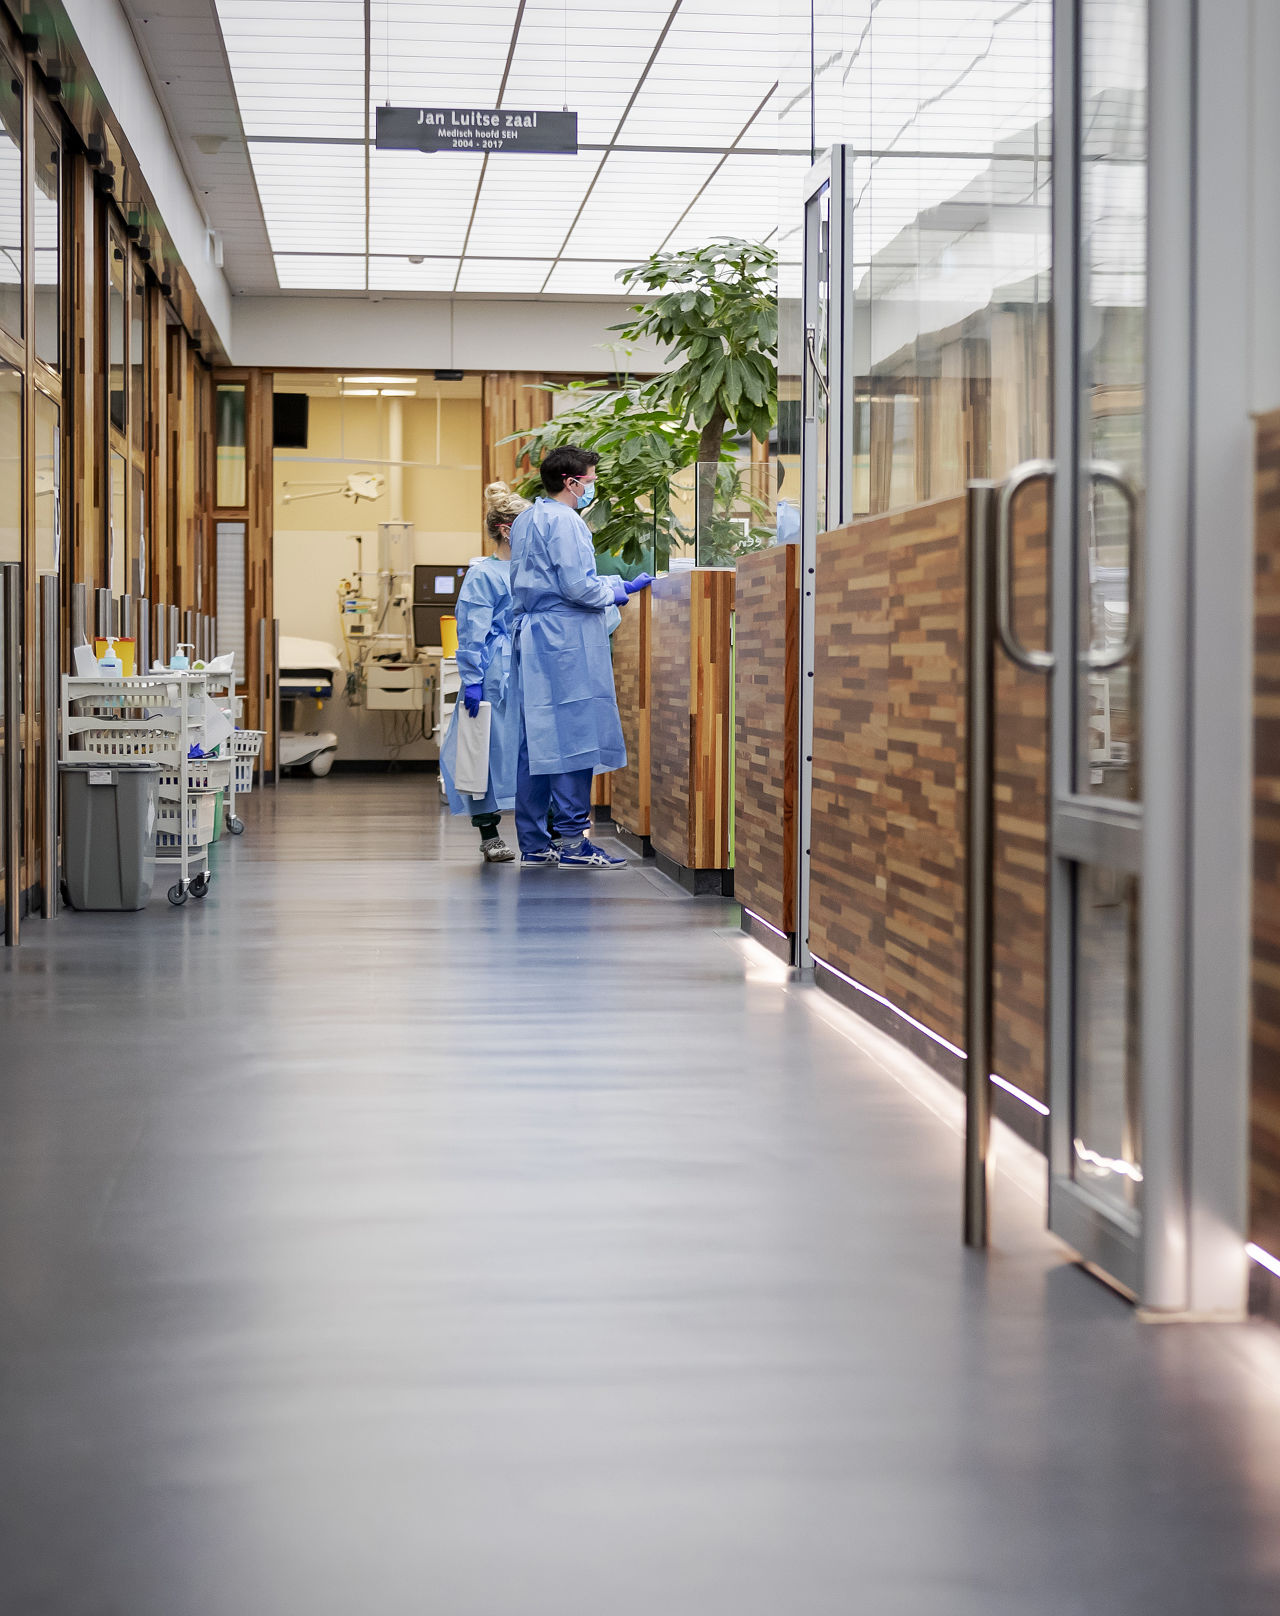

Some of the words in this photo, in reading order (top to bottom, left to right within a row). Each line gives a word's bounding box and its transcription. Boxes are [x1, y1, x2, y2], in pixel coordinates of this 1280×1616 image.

[417, 110, 445, 125] Jan
[451, 111, 500, 126] Luitse
[505, 112, 537, 128] zaal
[438, 128, 473, 138] Medisch
[475, 129, 500, 139] hoofd
[501, 130, 518, 139] SEH
[452, 139, 473, 148] 2004
[482, 140, 503, 148] 2017
